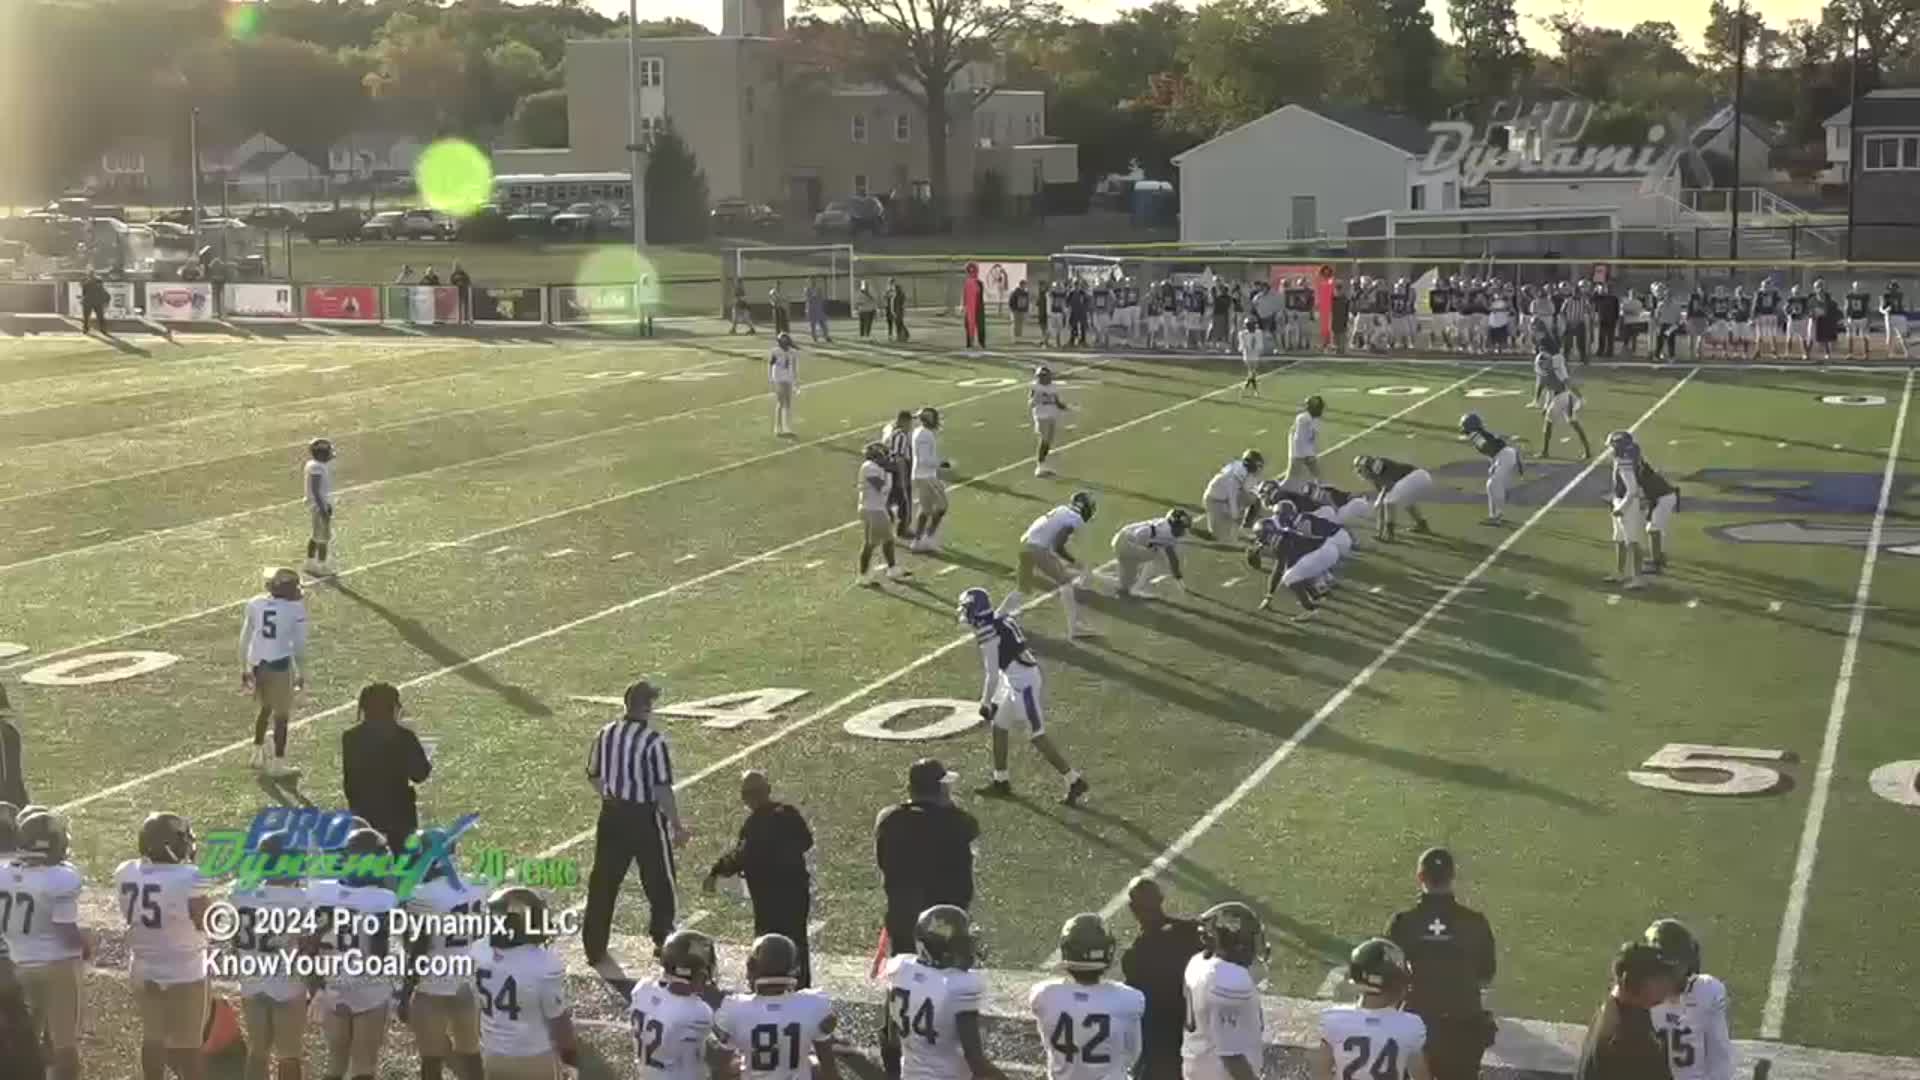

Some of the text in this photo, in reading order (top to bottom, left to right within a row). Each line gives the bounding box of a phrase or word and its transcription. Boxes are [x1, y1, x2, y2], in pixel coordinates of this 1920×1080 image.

[262, 610, 277, 639] 5
[121, 882, 162, 928] 75
[476, 969, 521, 1020] 54
[752, 1022, 801, 1071] 81
[1051, 1011, 1111, 1064] 42
[1344, 1036, 1400, 1080] 24
